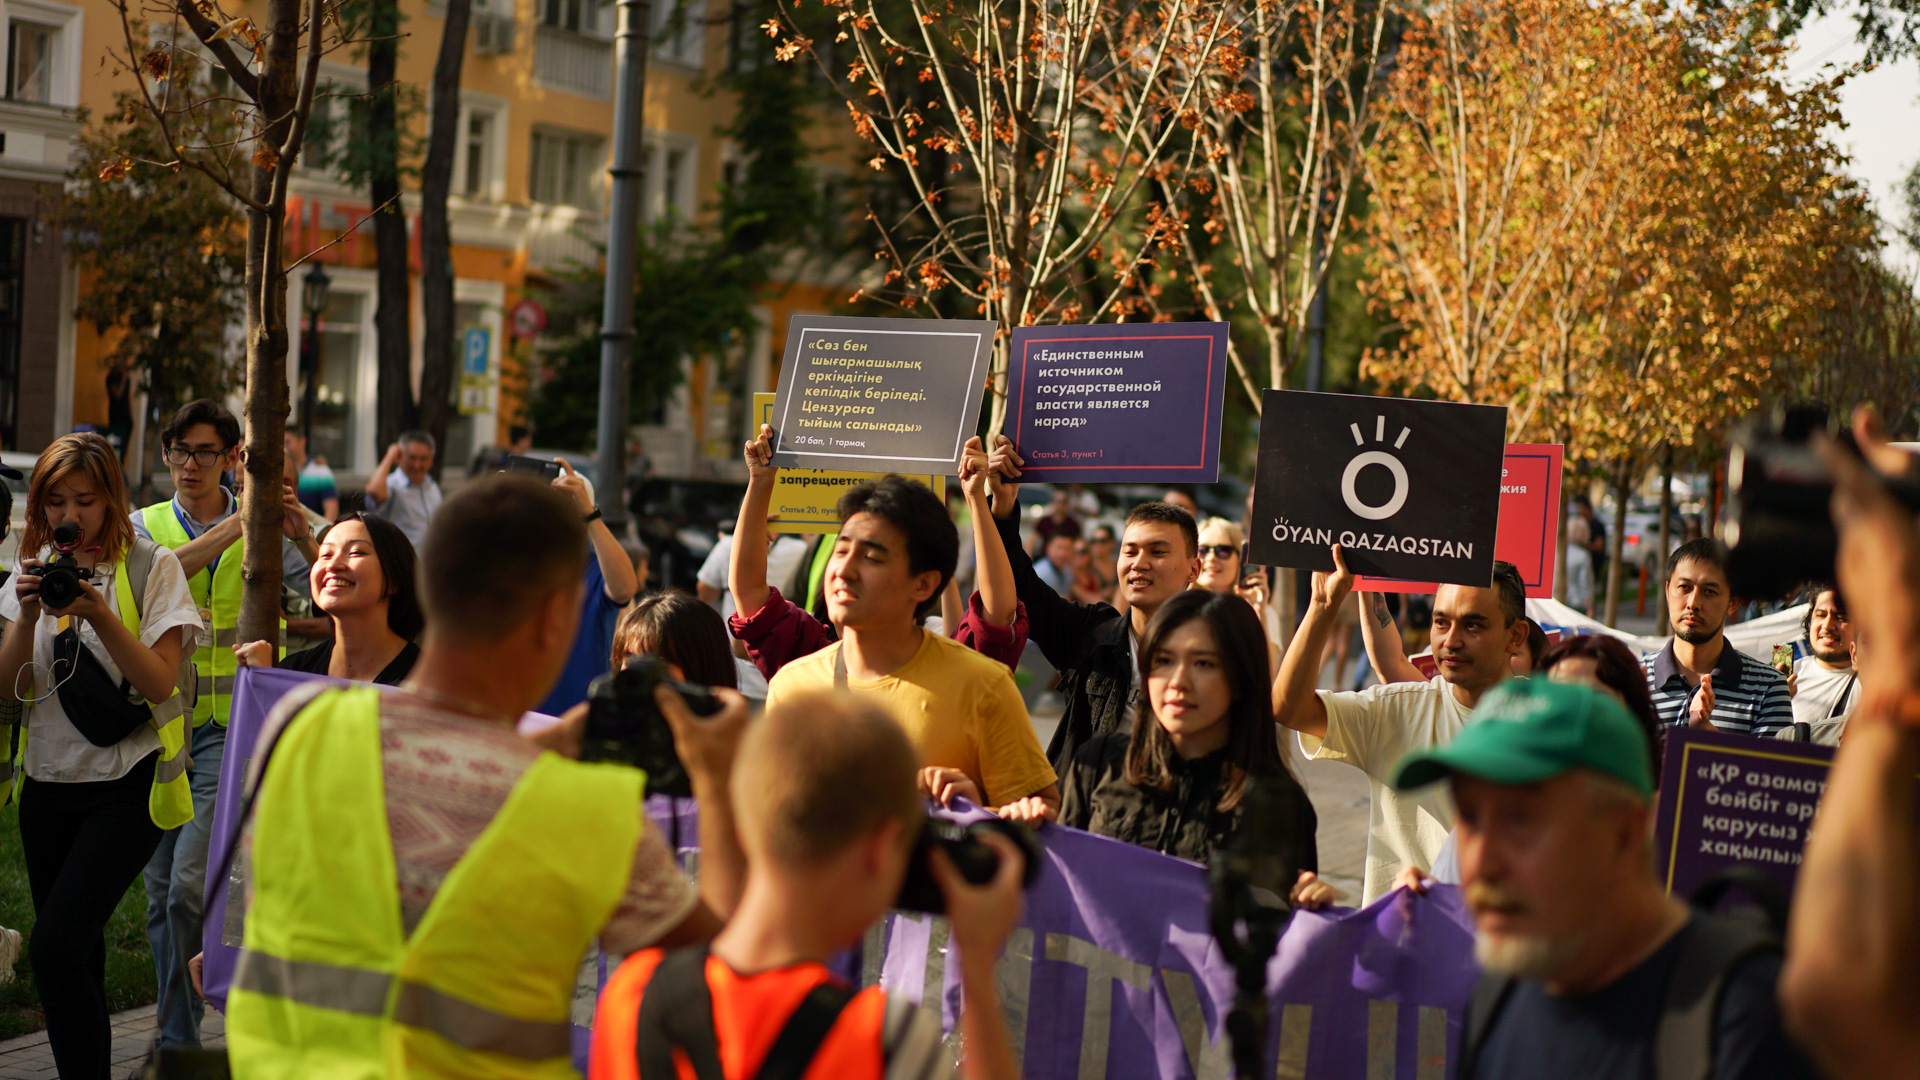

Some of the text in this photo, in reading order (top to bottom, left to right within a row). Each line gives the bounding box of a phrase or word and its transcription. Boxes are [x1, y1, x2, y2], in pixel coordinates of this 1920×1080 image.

[808, 339, 868, 352] «Сөз бен
[1033, 349, 1144, 363] «Единственным
[811, 356, 922, 371] шығармашылық
[808, 371, 883, 385] еркіндігіне
[1038, 367, 1124, 378] источником
[805, 386, 927, 402] кепілдік беріледі.
[1037, 380, 1162, 396] государственной
[801, 400, 875, 416] Цензураға
[1036, 399, 1150, 410] власти является
[798, 417, 922, 433] тыйым салынады»
[1034, 416, 1087, 429] народ»
[795, 436, 865, 448] 20 бап, 1 тармақ
[1032, 451, 1059, 459] Статья
[1061, 450, 1069, 459] 3,
[1072, 451, 1096, 459] пункт
[780, 476, 872, 488] запрещается
[1500, 485, 1527, 494] жия
[780, 505, 838, 516] Статья 20, пун
[1339, 530, 1473, 560] QAZAQSTAN
[1697, 761, 1827, 795] «ҚР азамат
[1705, 786, 1781, 813] бейбіт
[1702, 814, 1798, 840] қарусыз
[1699, 838, 1803, 865] хақылы»
